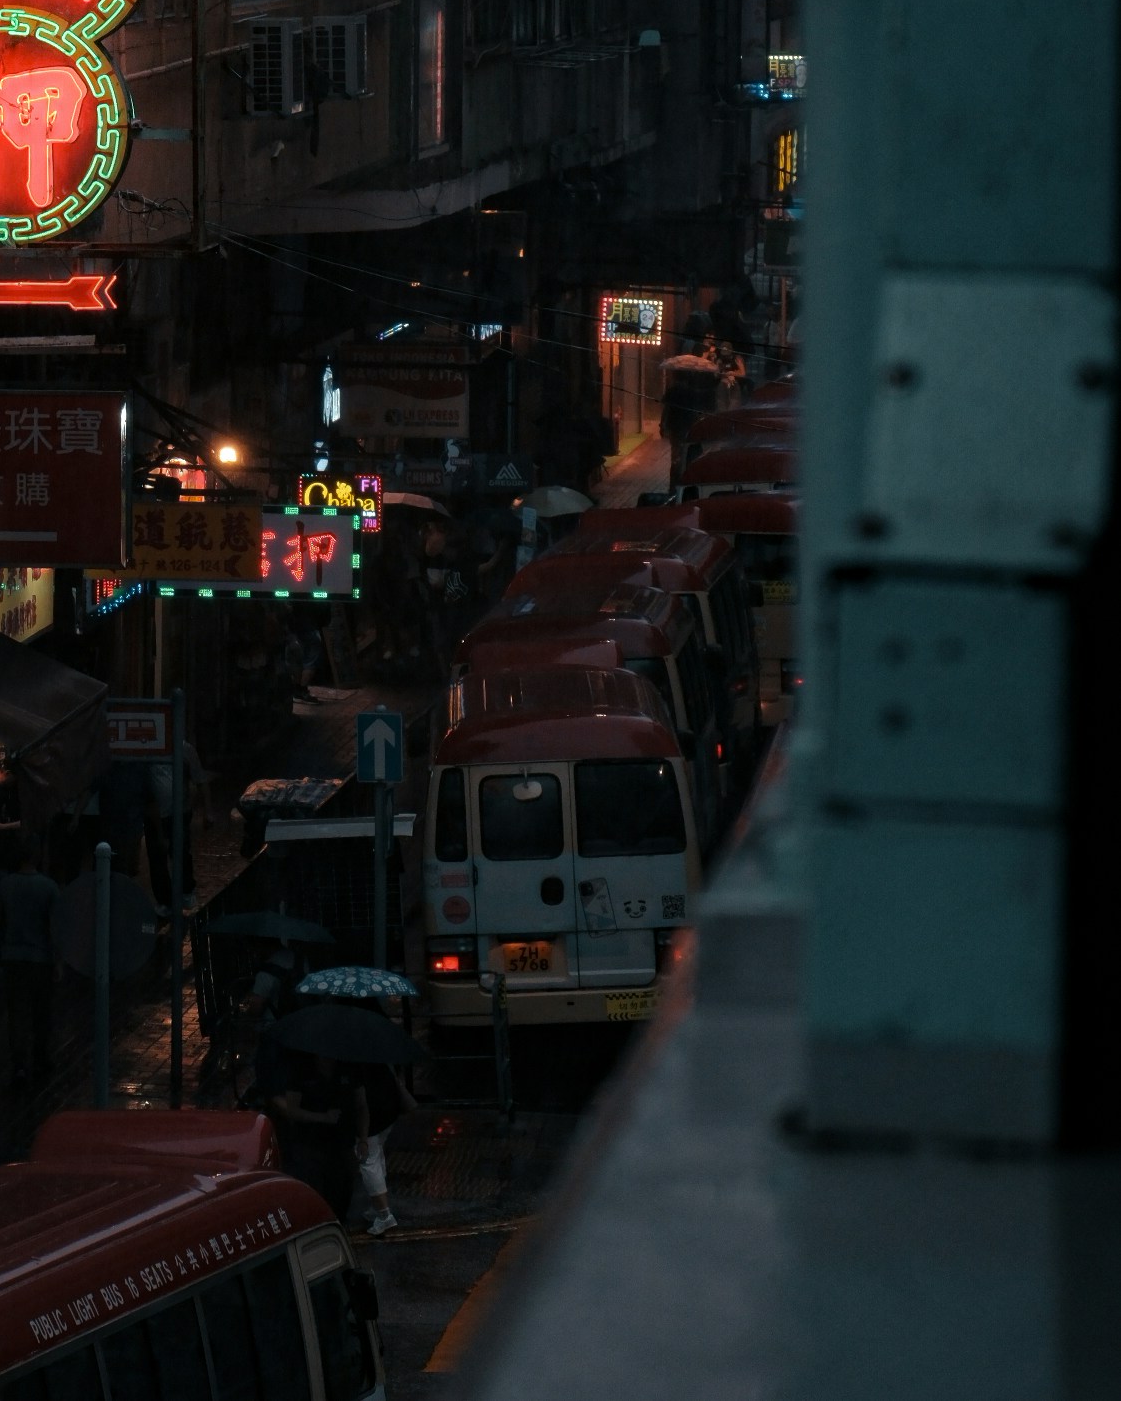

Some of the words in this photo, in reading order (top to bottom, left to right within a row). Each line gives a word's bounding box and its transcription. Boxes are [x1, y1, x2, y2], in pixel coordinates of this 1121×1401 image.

[417, 409, 460, 421] EXPRESS
[405, 470, 443, 485] CHUMS
[361, 479, 378, 493] F1
[518, 947, 539, 960] ZH
[508, 959, 549, 971] 5768
[29, 1308, 68, 1344] PUBLIC
[67, 1293, 100, 1326] LIGHT
[99, 1285, 124, 1312] BUS
[124, 1275, 140, 1300] 16
[139, 1259, 174, 1292] SEATS
